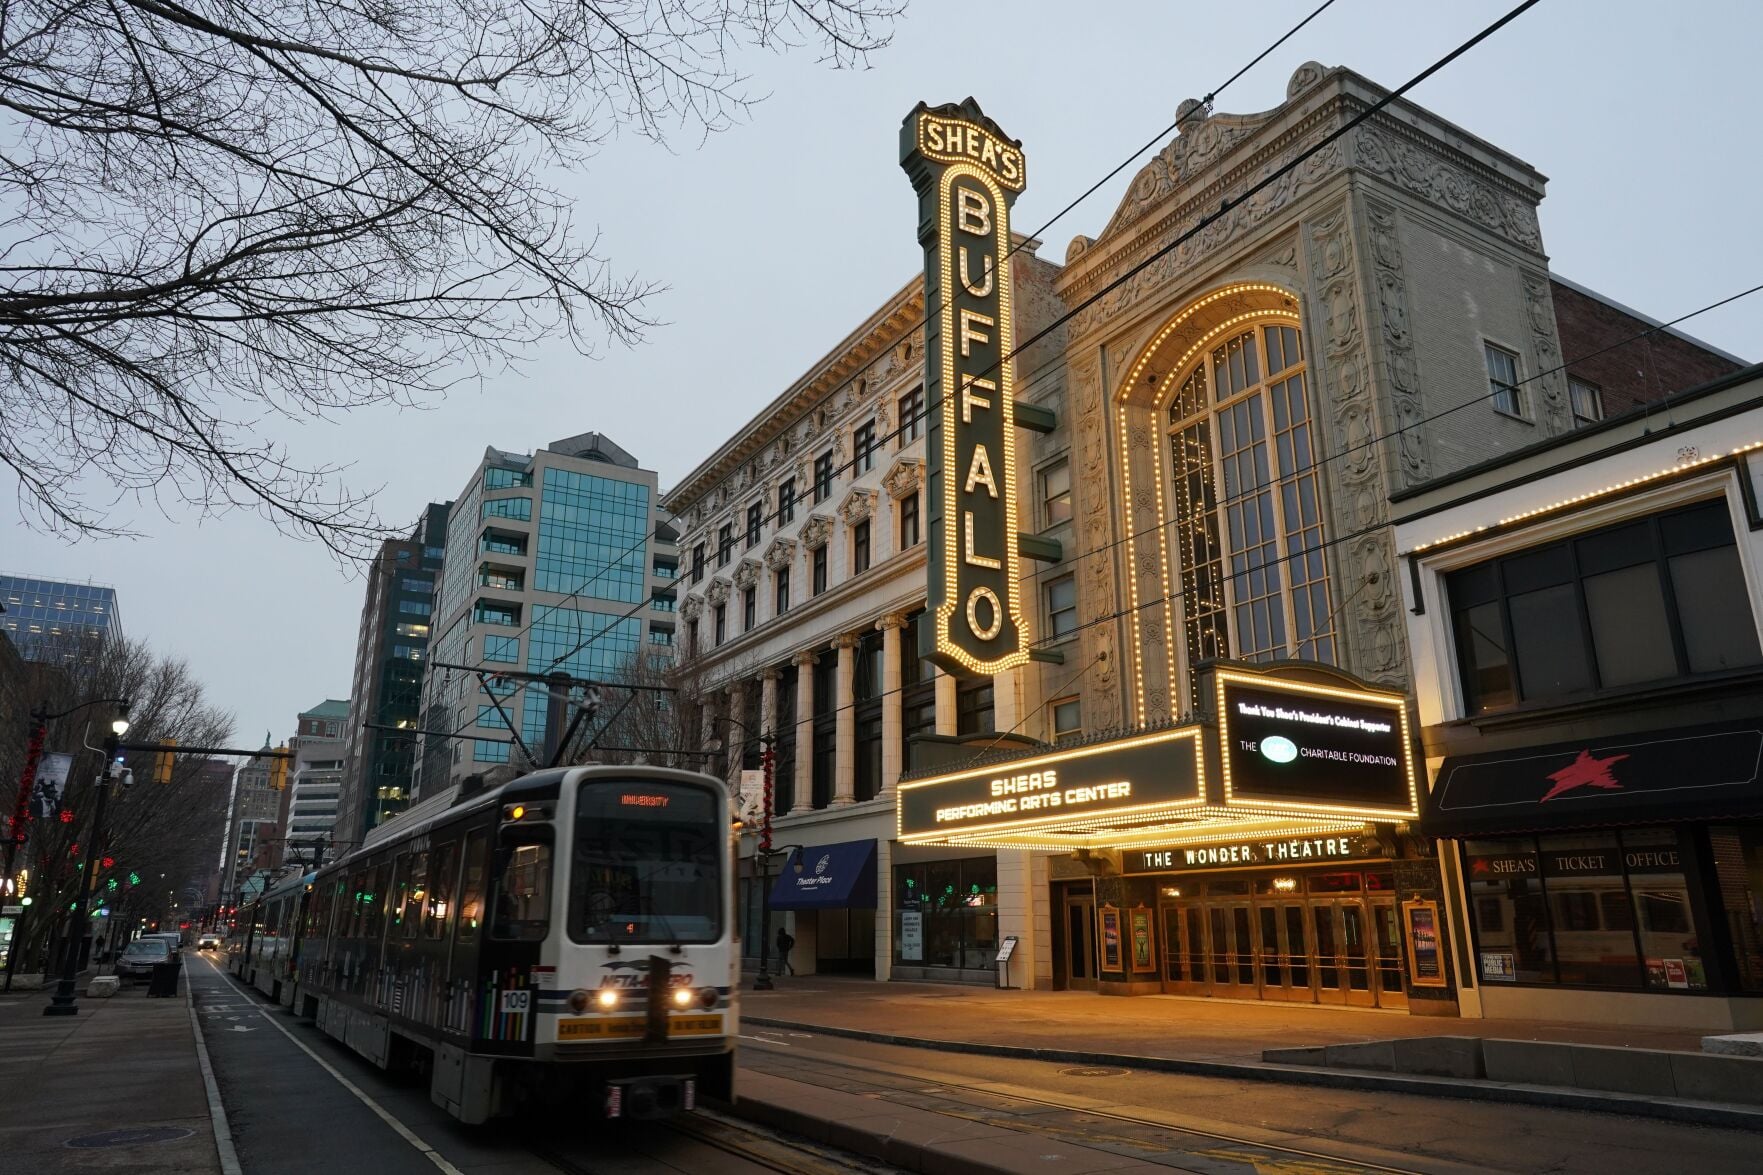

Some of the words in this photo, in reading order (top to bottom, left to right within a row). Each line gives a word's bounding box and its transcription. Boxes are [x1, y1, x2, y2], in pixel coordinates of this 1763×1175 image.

[927, 122, 1018, 179] SHEA'S
[957, 185, 1003, 642] BUFFALO
[1238, 703, 1260, 716] Thank
[1261, 706, 1275, 717] You
[1275, 708, 1298, 721] Shea's
[1299, 711, 1334, 725] President's
[1334, 716, 1360, 729] Cabinet
[1360, 719, 1391, 732] Supporter
[1240, 740, 1257, 752] THE
[1300, 747, 1348, 761] CHARITABLE
[1349, 752, 1397, 766] FOUNDATION
[991, 770, 1056, 796] SHEAS
[936, 799, 1017, 822] PERFORMING
[1020, 791, 1061, 810] ARTS
[1065, 781, 1130, 804] CENTER
[1145, 852, 1172, 867] THE
[1186, 845, 1250, 865] WONDER
[1266, 838, 1350, 860] THEATRE
[1492, 858, 1536, 873] SHEA'S
[1555, 855, 1606, 871] TICKET
[1625, 851, 1680, 868] OFFICE
[503, 992, 528, 1009] 109
